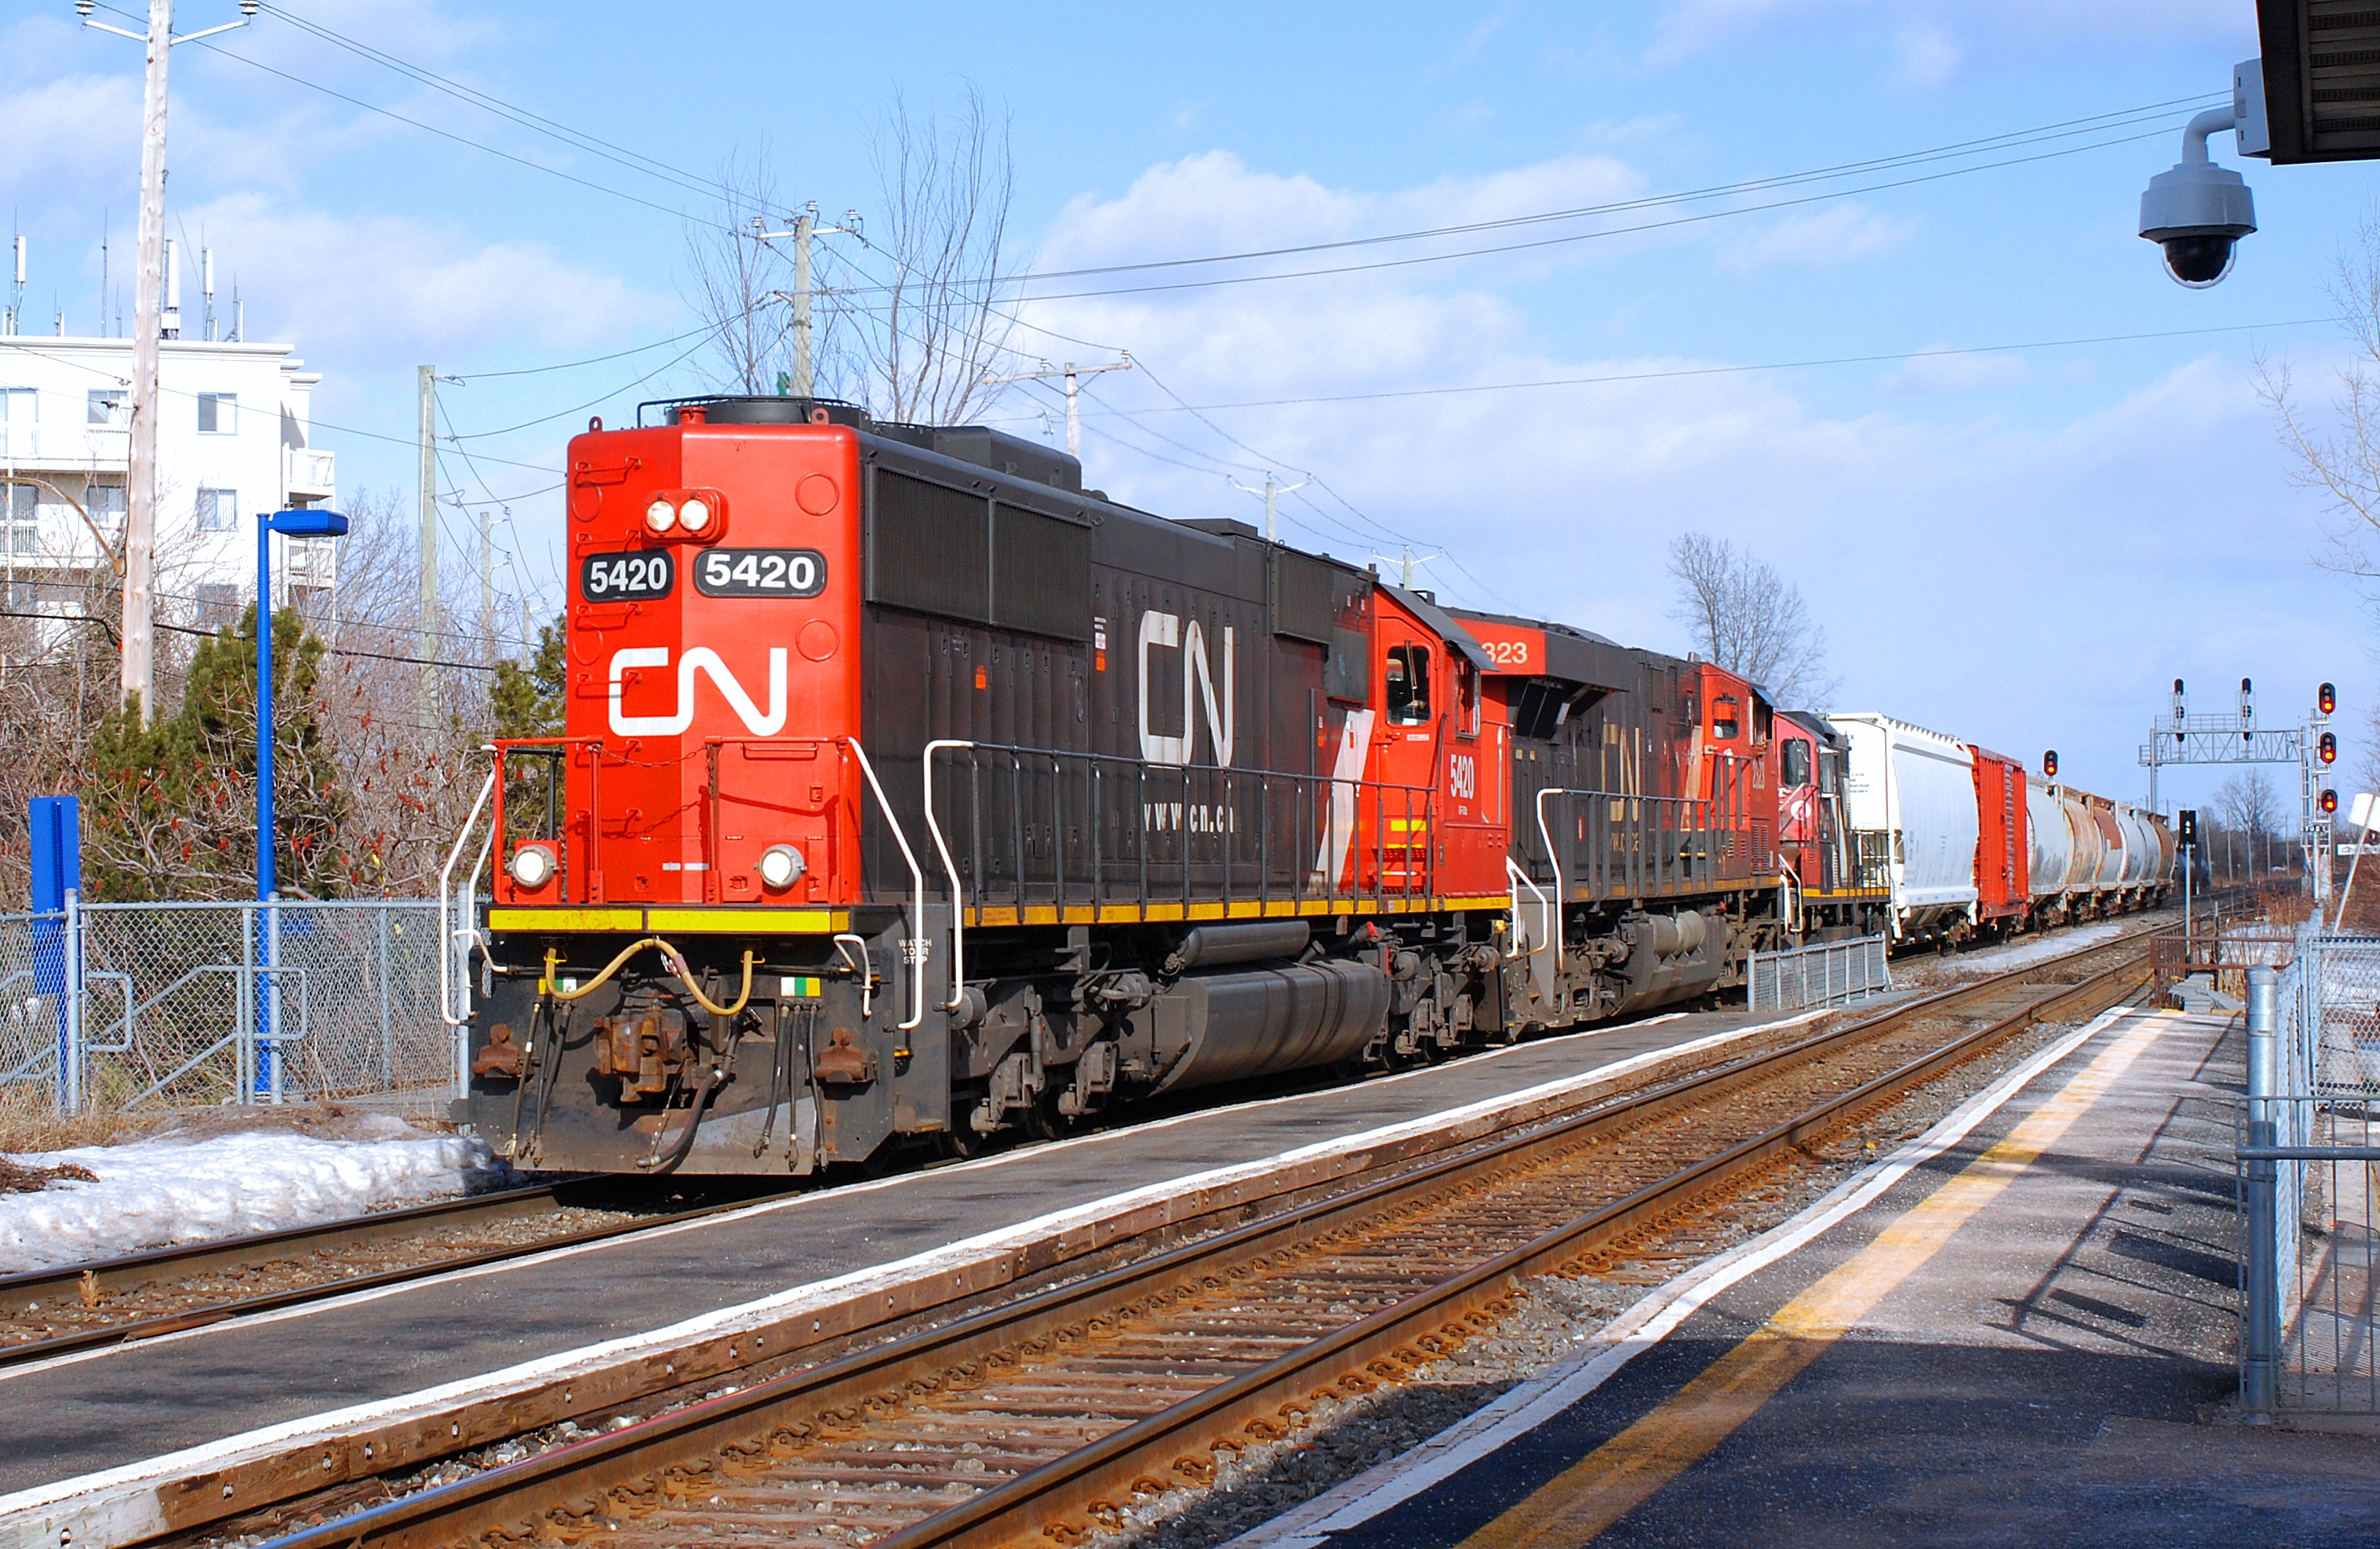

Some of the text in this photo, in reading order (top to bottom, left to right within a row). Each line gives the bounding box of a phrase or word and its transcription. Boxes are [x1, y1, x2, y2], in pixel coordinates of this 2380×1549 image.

[590, 557, 668, 594] 5420
[704, 554, 815, 590] 5420
[1481, 641, 1528, 664] 323
[609, 647, 788, 737] CN
[1139, 610, 1233, 769] CN
[1450, 753, 1475, 800] 5420
